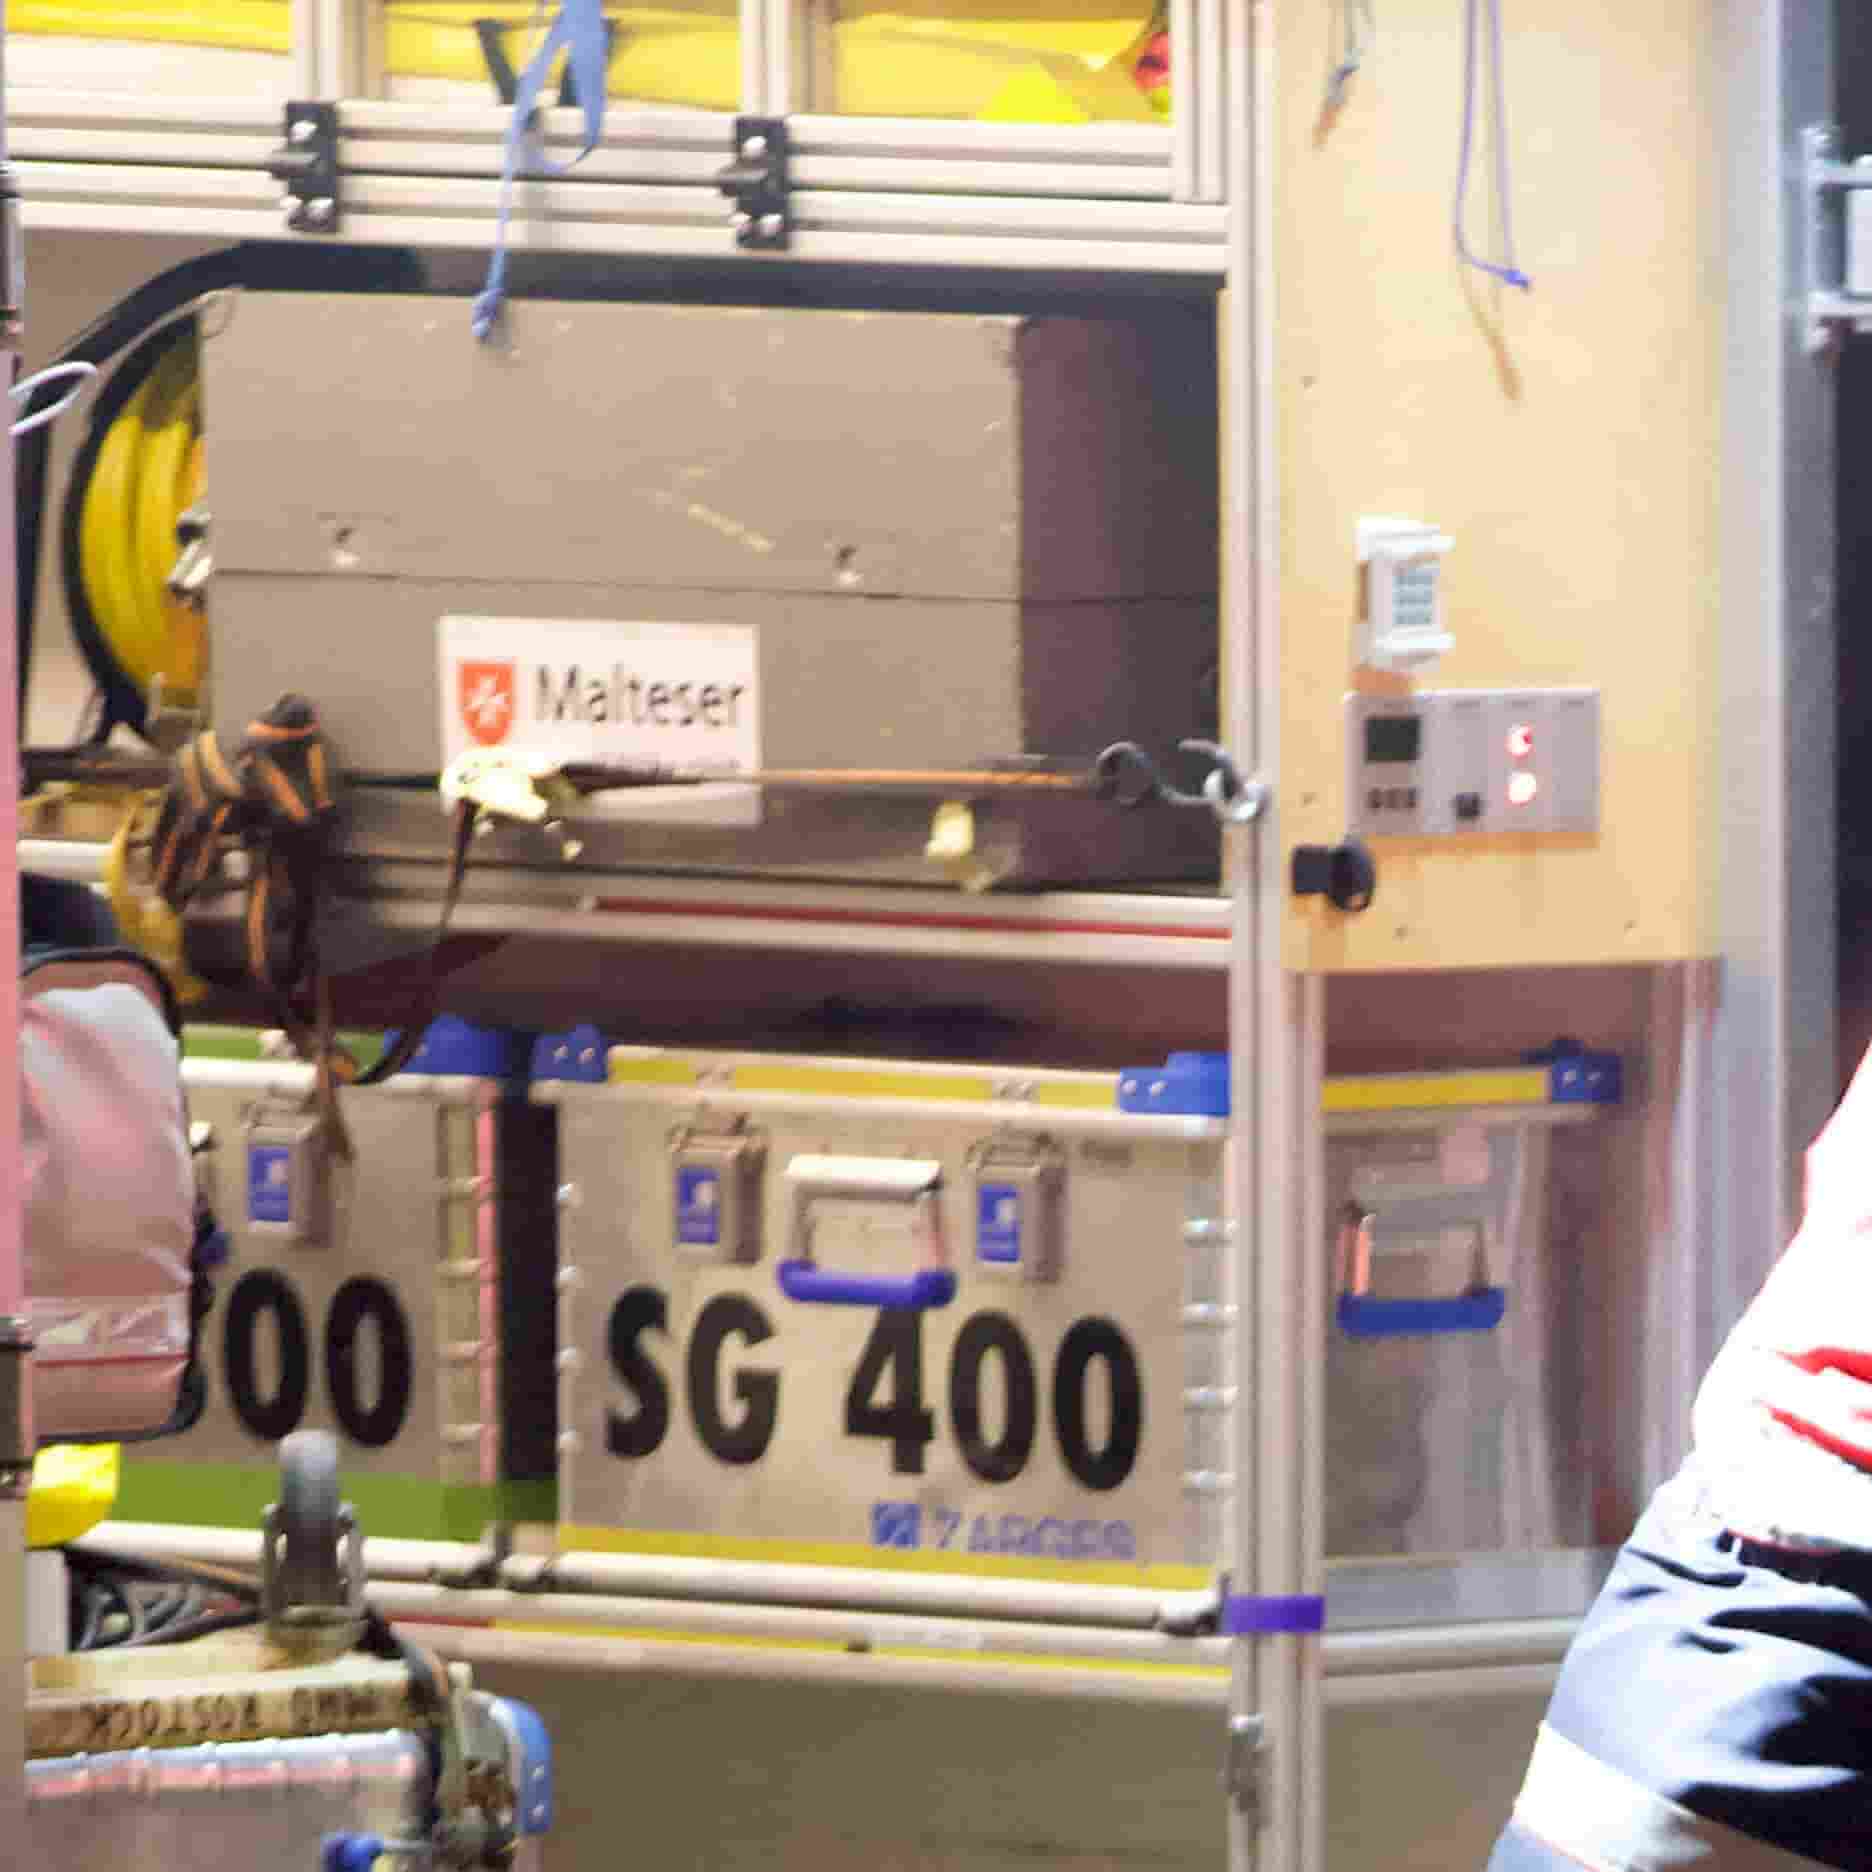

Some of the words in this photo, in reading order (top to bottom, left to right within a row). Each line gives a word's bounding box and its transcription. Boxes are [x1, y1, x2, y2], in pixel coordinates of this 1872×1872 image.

[535, 661, 746, 727] Malteser
[225, 1267, 412, 1448] 00
[606, 1284, 781, 1465] SG
[844, 1306, 1143, 1491] 400
